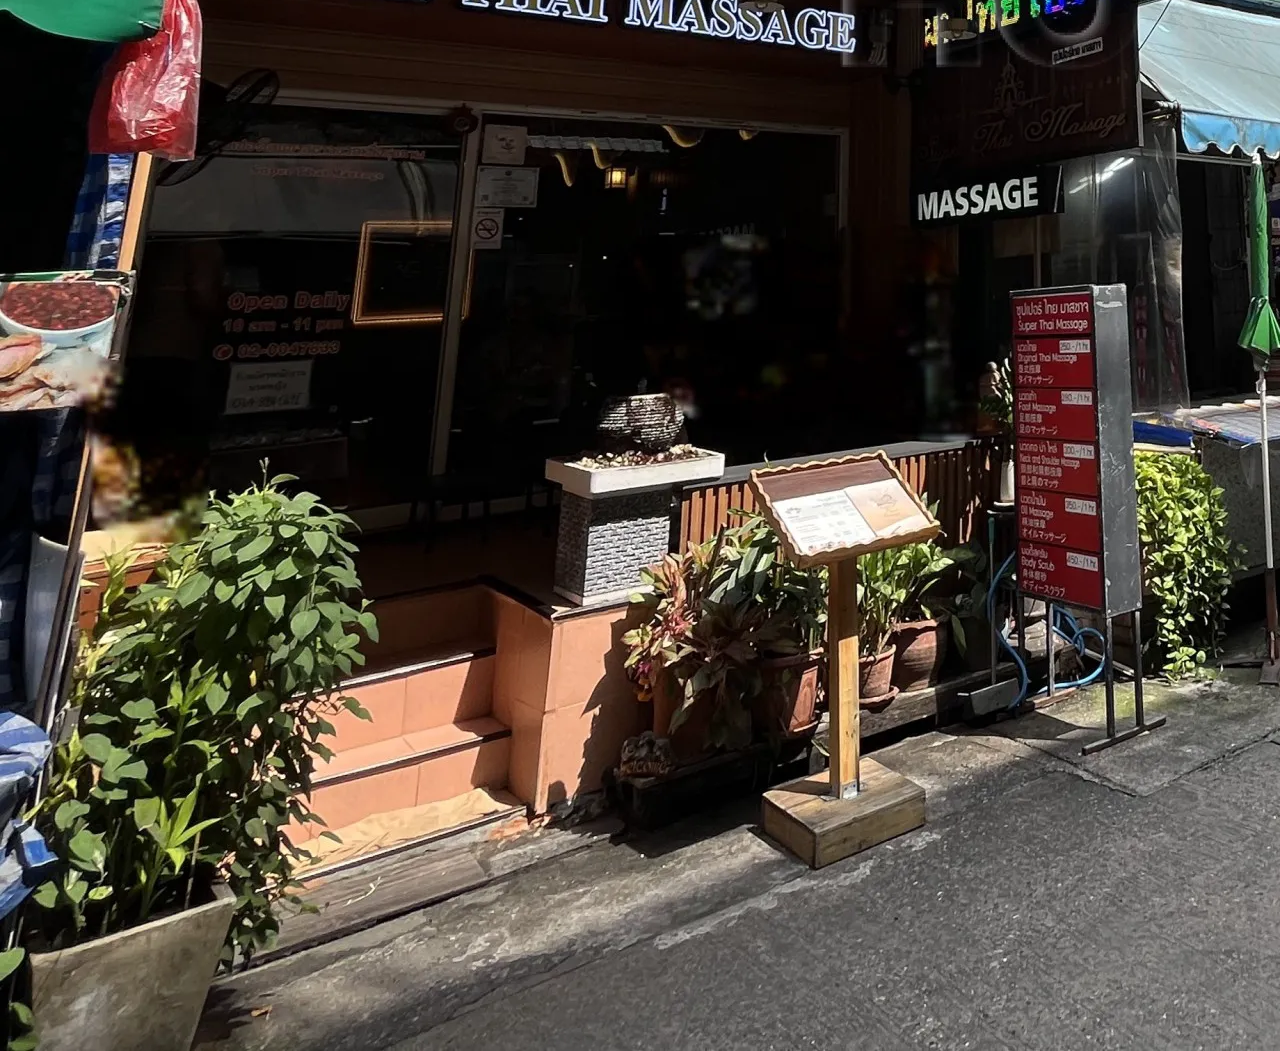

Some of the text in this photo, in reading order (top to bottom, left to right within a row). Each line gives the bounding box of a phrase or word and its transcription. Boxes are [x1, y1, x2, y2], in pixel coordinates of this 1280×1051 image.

[1024, 101, 1128, 143] Massage
[917, 175, 1039, 222] MASSAGE
[227, 290, 350, 314] Open Daily
[1043, 298, 1058, 314] ไทย
[1018, 318, 1088, 333] Super Thai Massage
[1038, 353, 1051, 362] Thai
[1052, 353, 1077, 364] Massage
[1018, 401, 1031, 411] Foot
[1020, 505, 1054, 521] Oil Massage
[1021, 527, 1067, 543] オイルマッサージ
[1021, 555, 1037, 569] Body
